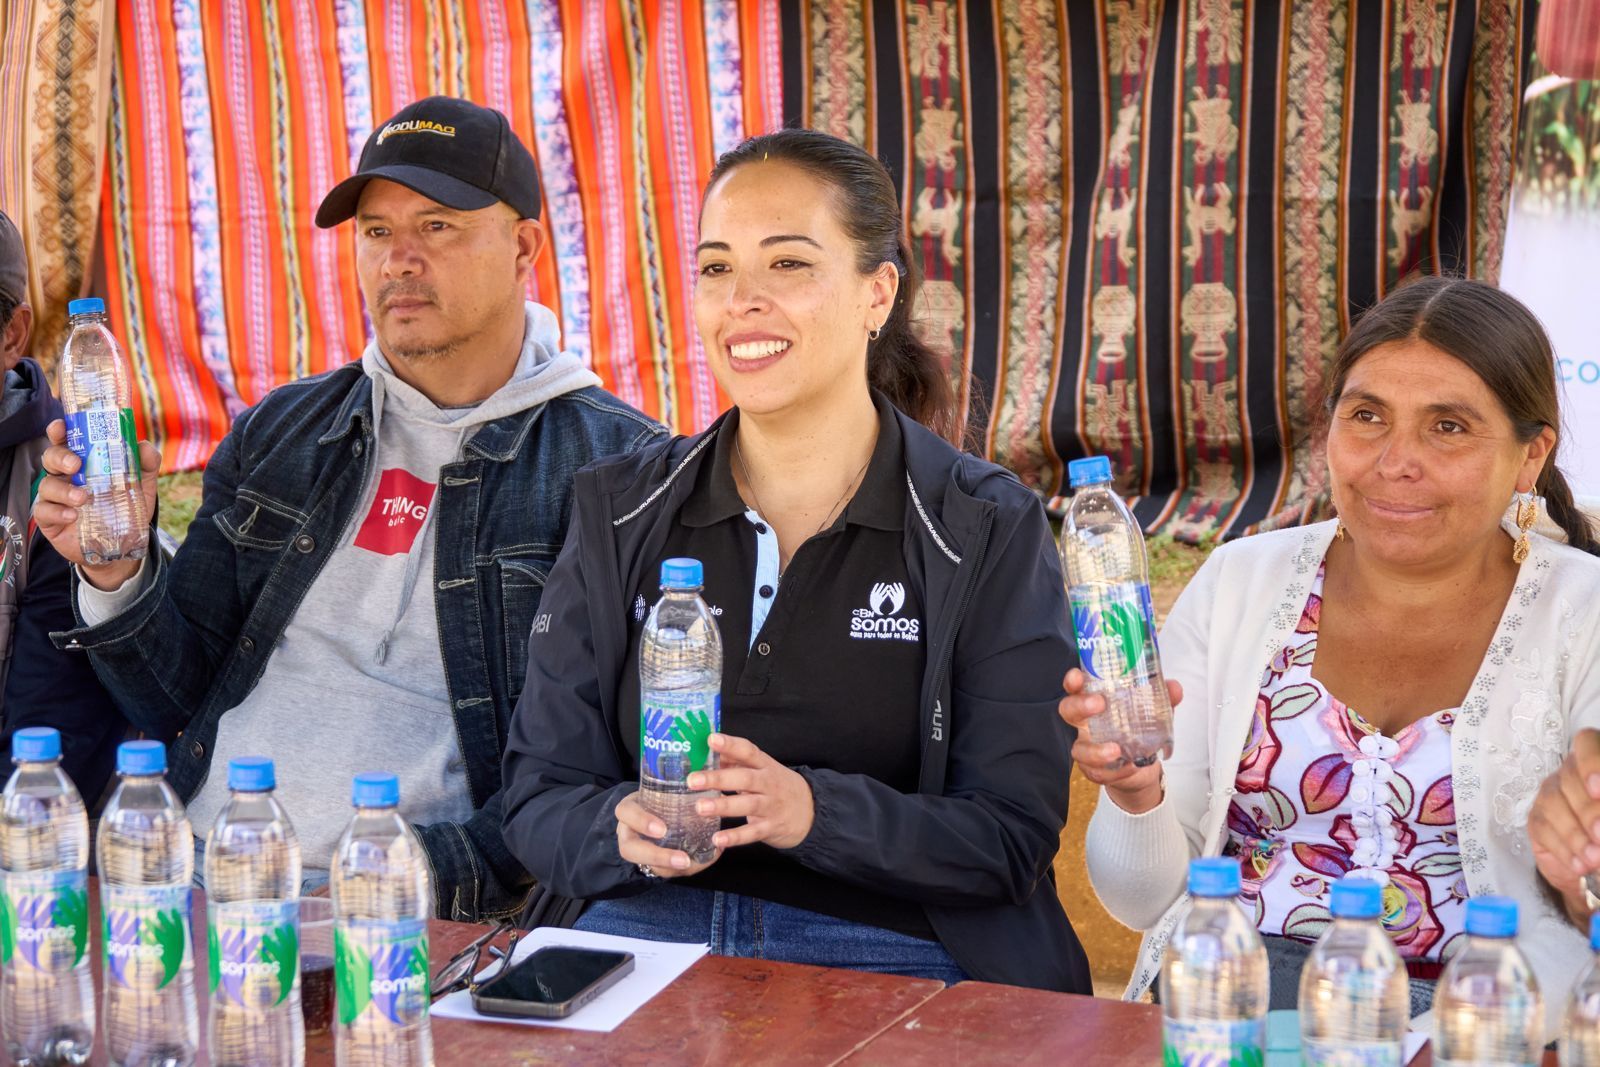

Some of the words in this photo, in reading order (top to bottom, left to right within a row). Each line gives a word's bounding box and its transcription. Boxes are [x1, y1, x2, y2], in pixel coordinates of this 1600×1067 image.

[643, 735, 691, 752] somos
[16, 924, 76, 943] somos
[107, 940, 164, 958] somos
[219, 960, 280, 977] somos
[370, 971, 426, 995] somos
